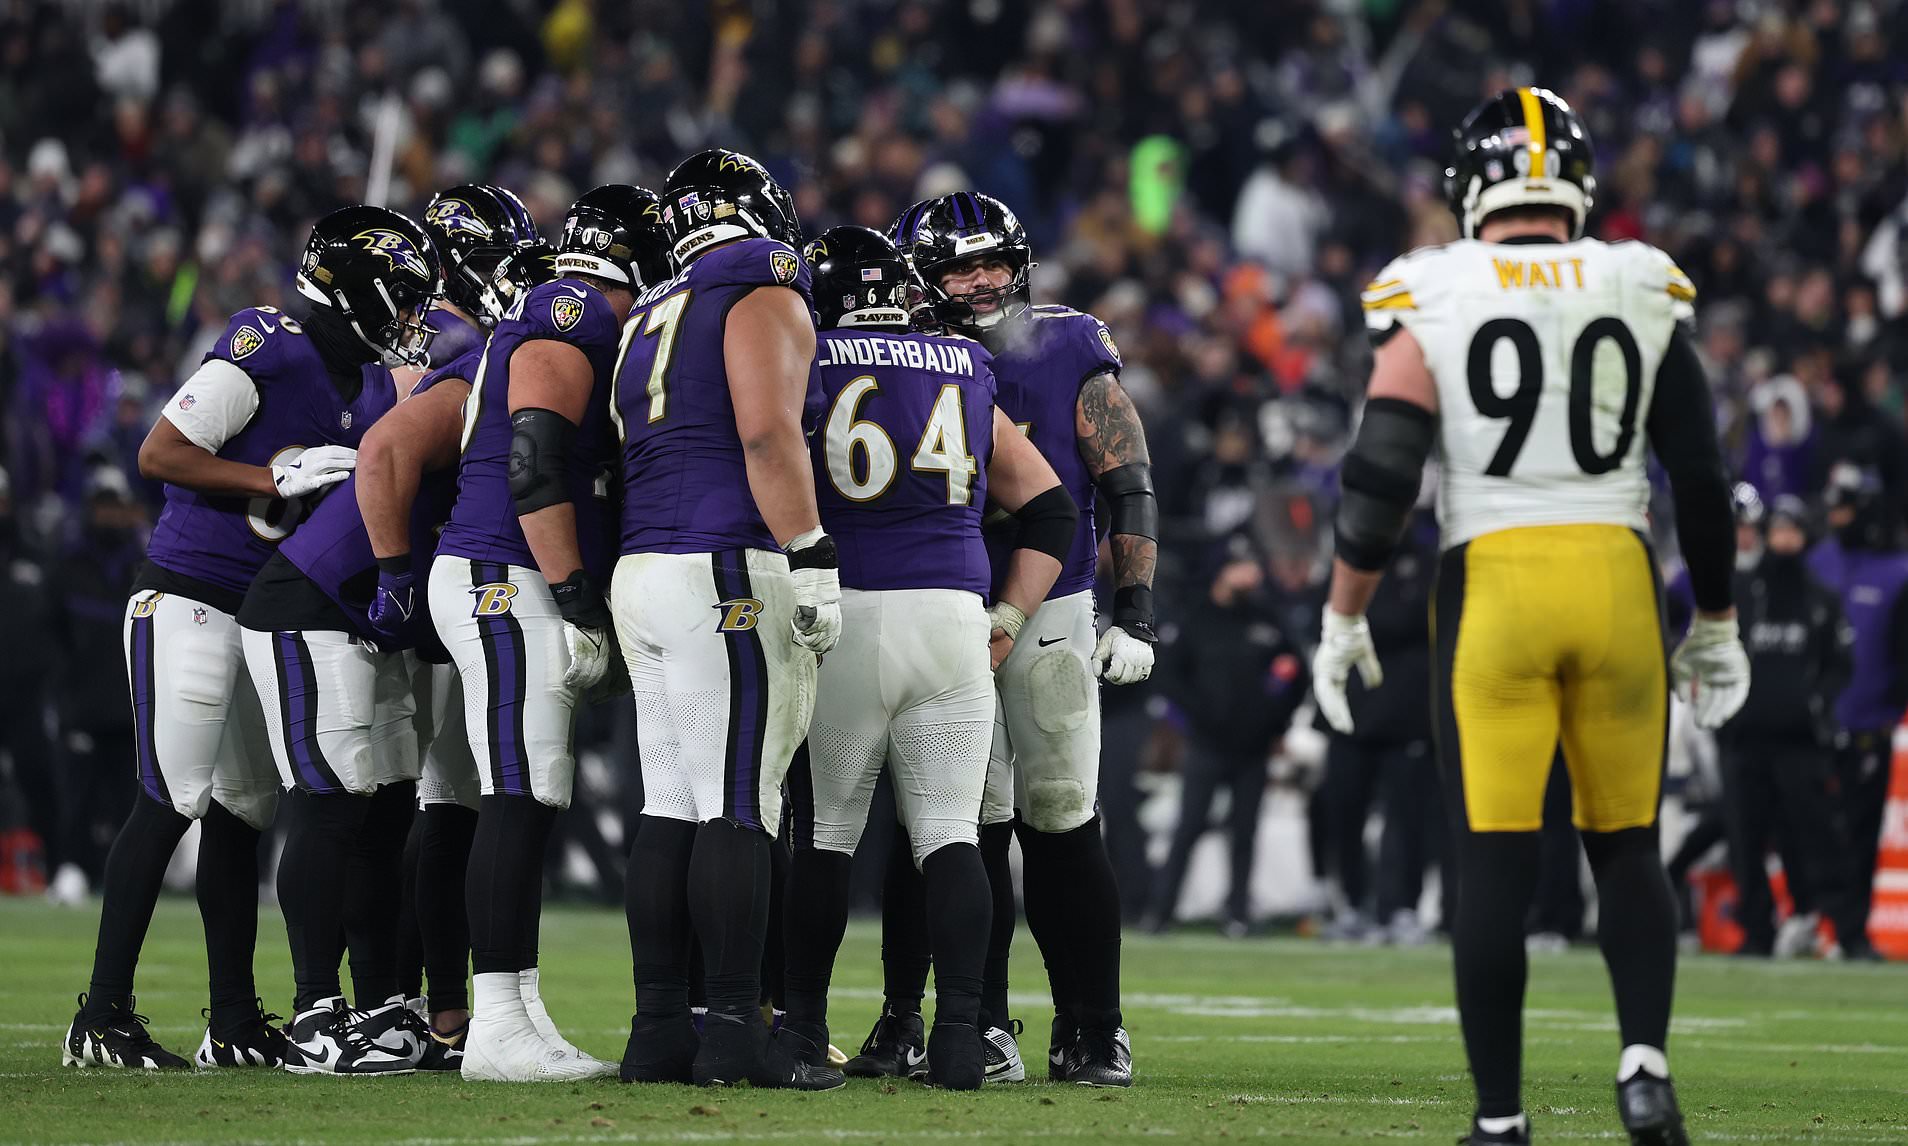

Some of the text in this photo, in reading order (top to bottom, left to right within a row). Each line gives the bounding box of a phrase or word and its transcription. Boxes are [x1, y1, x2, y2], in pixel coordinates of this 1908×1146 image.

[438, 201, 461, 218] B
[376, 231, 403, 249] B
[676, 231, 715, 257] RAVENS
[557, 258, 600, 271] RAVENS
[1491, 256, 1584, 289] WATT
[867, 287, 896, 305] 64
[855, 313, 904, 323] RAVENS
[1467, 317, 1642, 478] 90
[823, 374, 977, 506] 64
[468, 582, 519, 618] B
[711, 598, 765, 634] B
